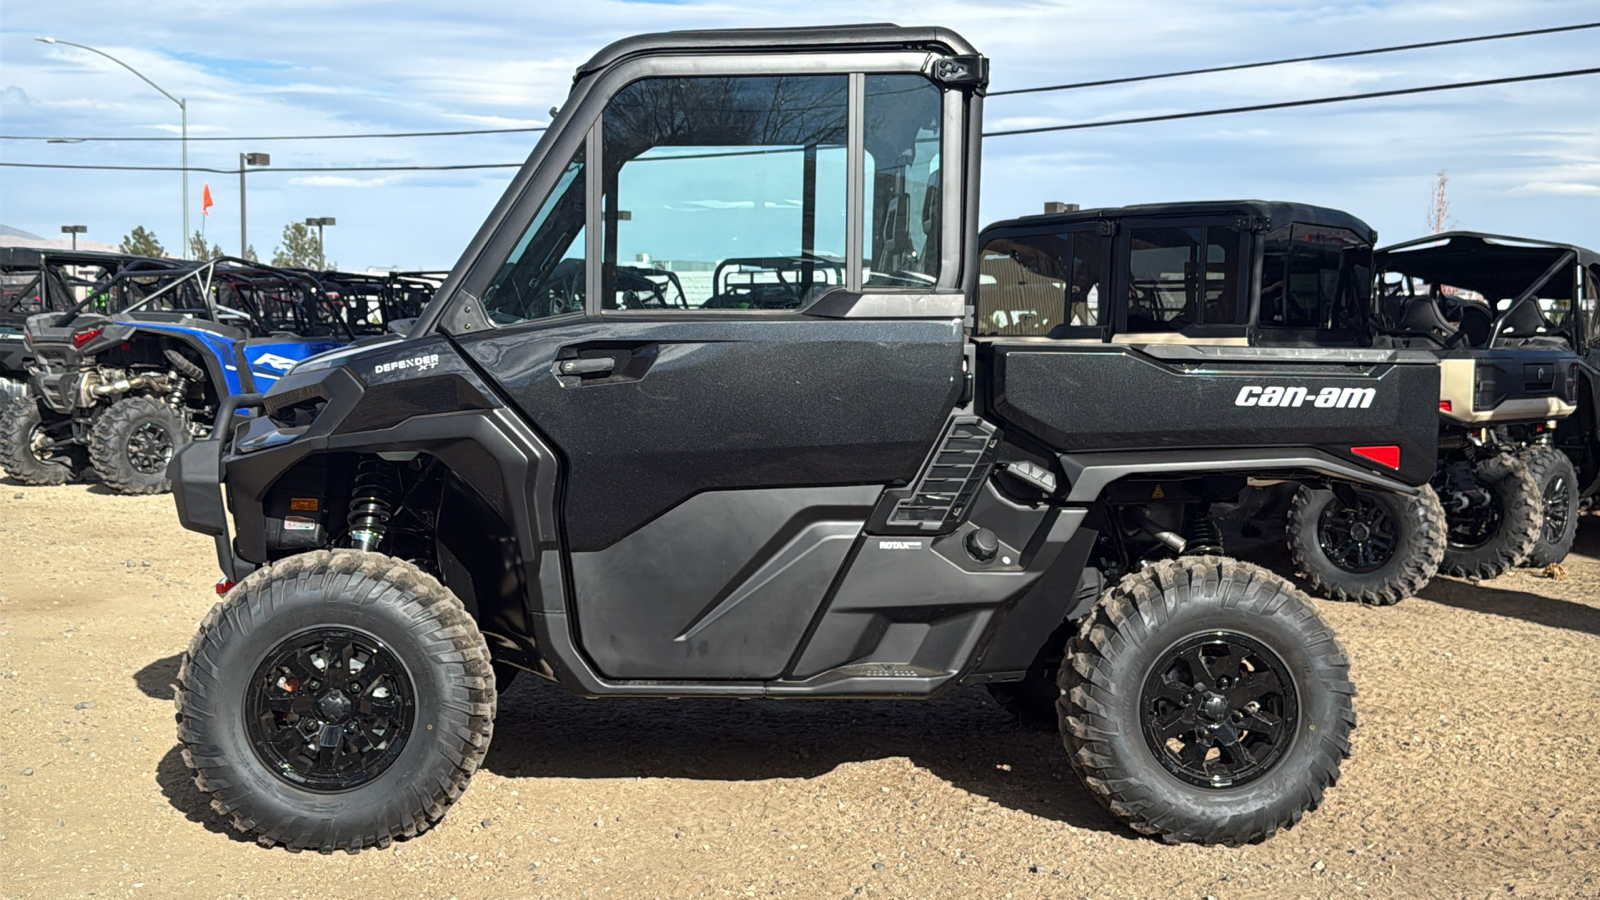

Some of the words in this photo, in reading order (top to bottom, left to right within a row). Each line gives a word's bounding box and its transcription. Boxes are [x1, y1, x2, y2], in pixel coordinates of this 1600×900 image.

[375, 354, 439, 374] DEFENDER
[417, 362, 439, 372] XT
[1234, 386, 1376, 408] can-am
[879, 541, 909, 550] ROTAX
